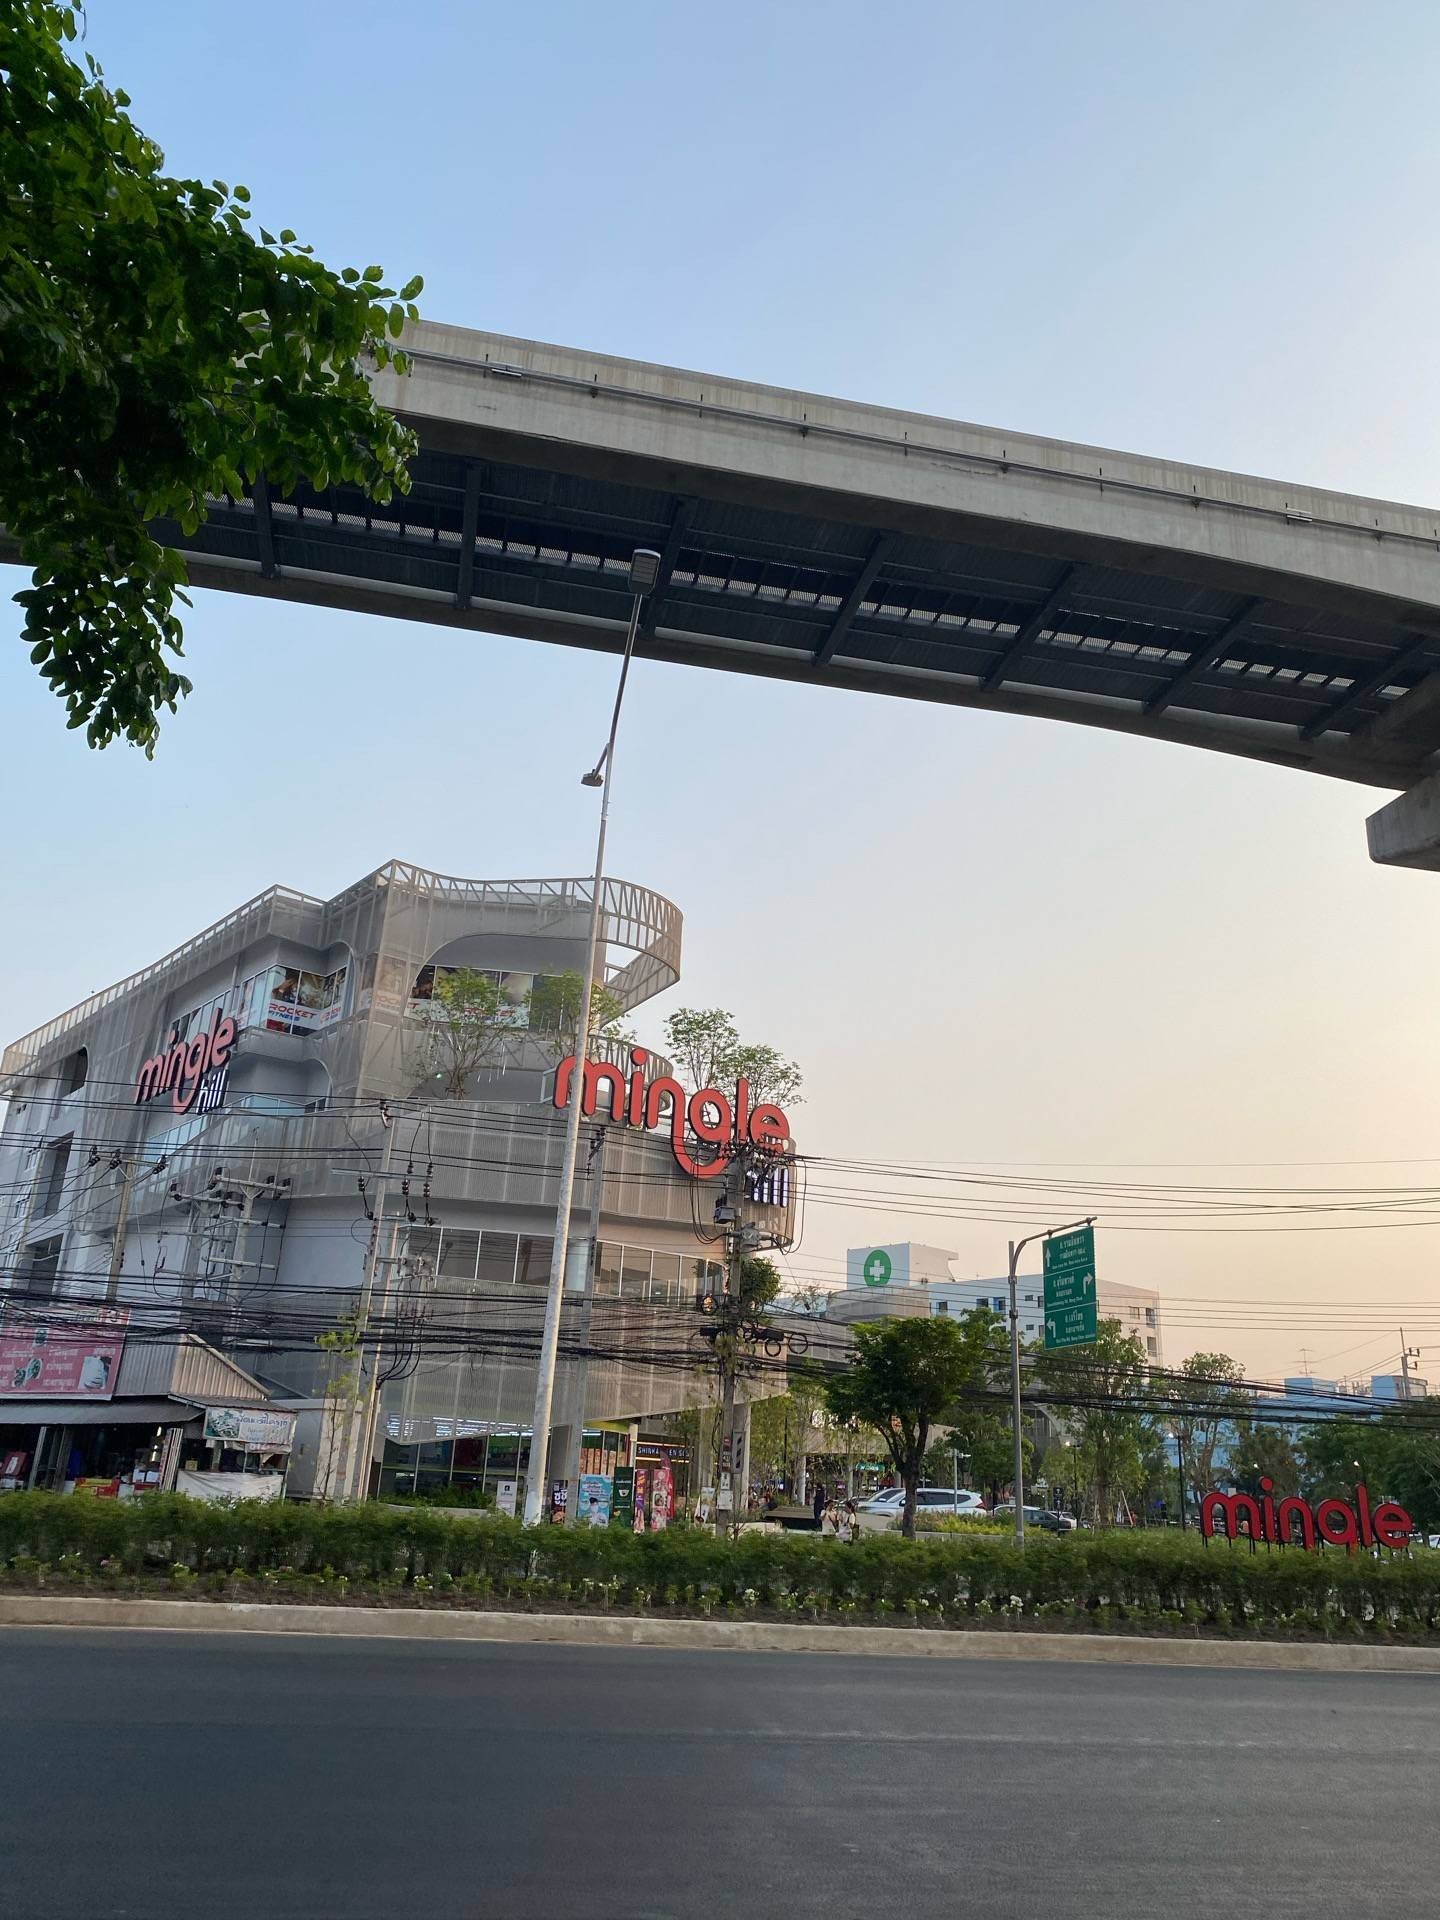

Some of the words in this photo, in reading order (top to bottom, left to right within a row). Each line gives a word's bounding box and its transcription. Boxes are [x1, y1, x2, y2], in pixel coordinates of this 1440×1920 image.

[269, 1003, 318, 1019] ROCKET
[269, 1010, 300, 1022] FITNESS
[134, 1008, 237, 1115] mingle
[196, 1069, 228, 1114] hill
[554, 1048, 790, 1179] mingle
[1201, 1475, 1414, 1555] mingle
